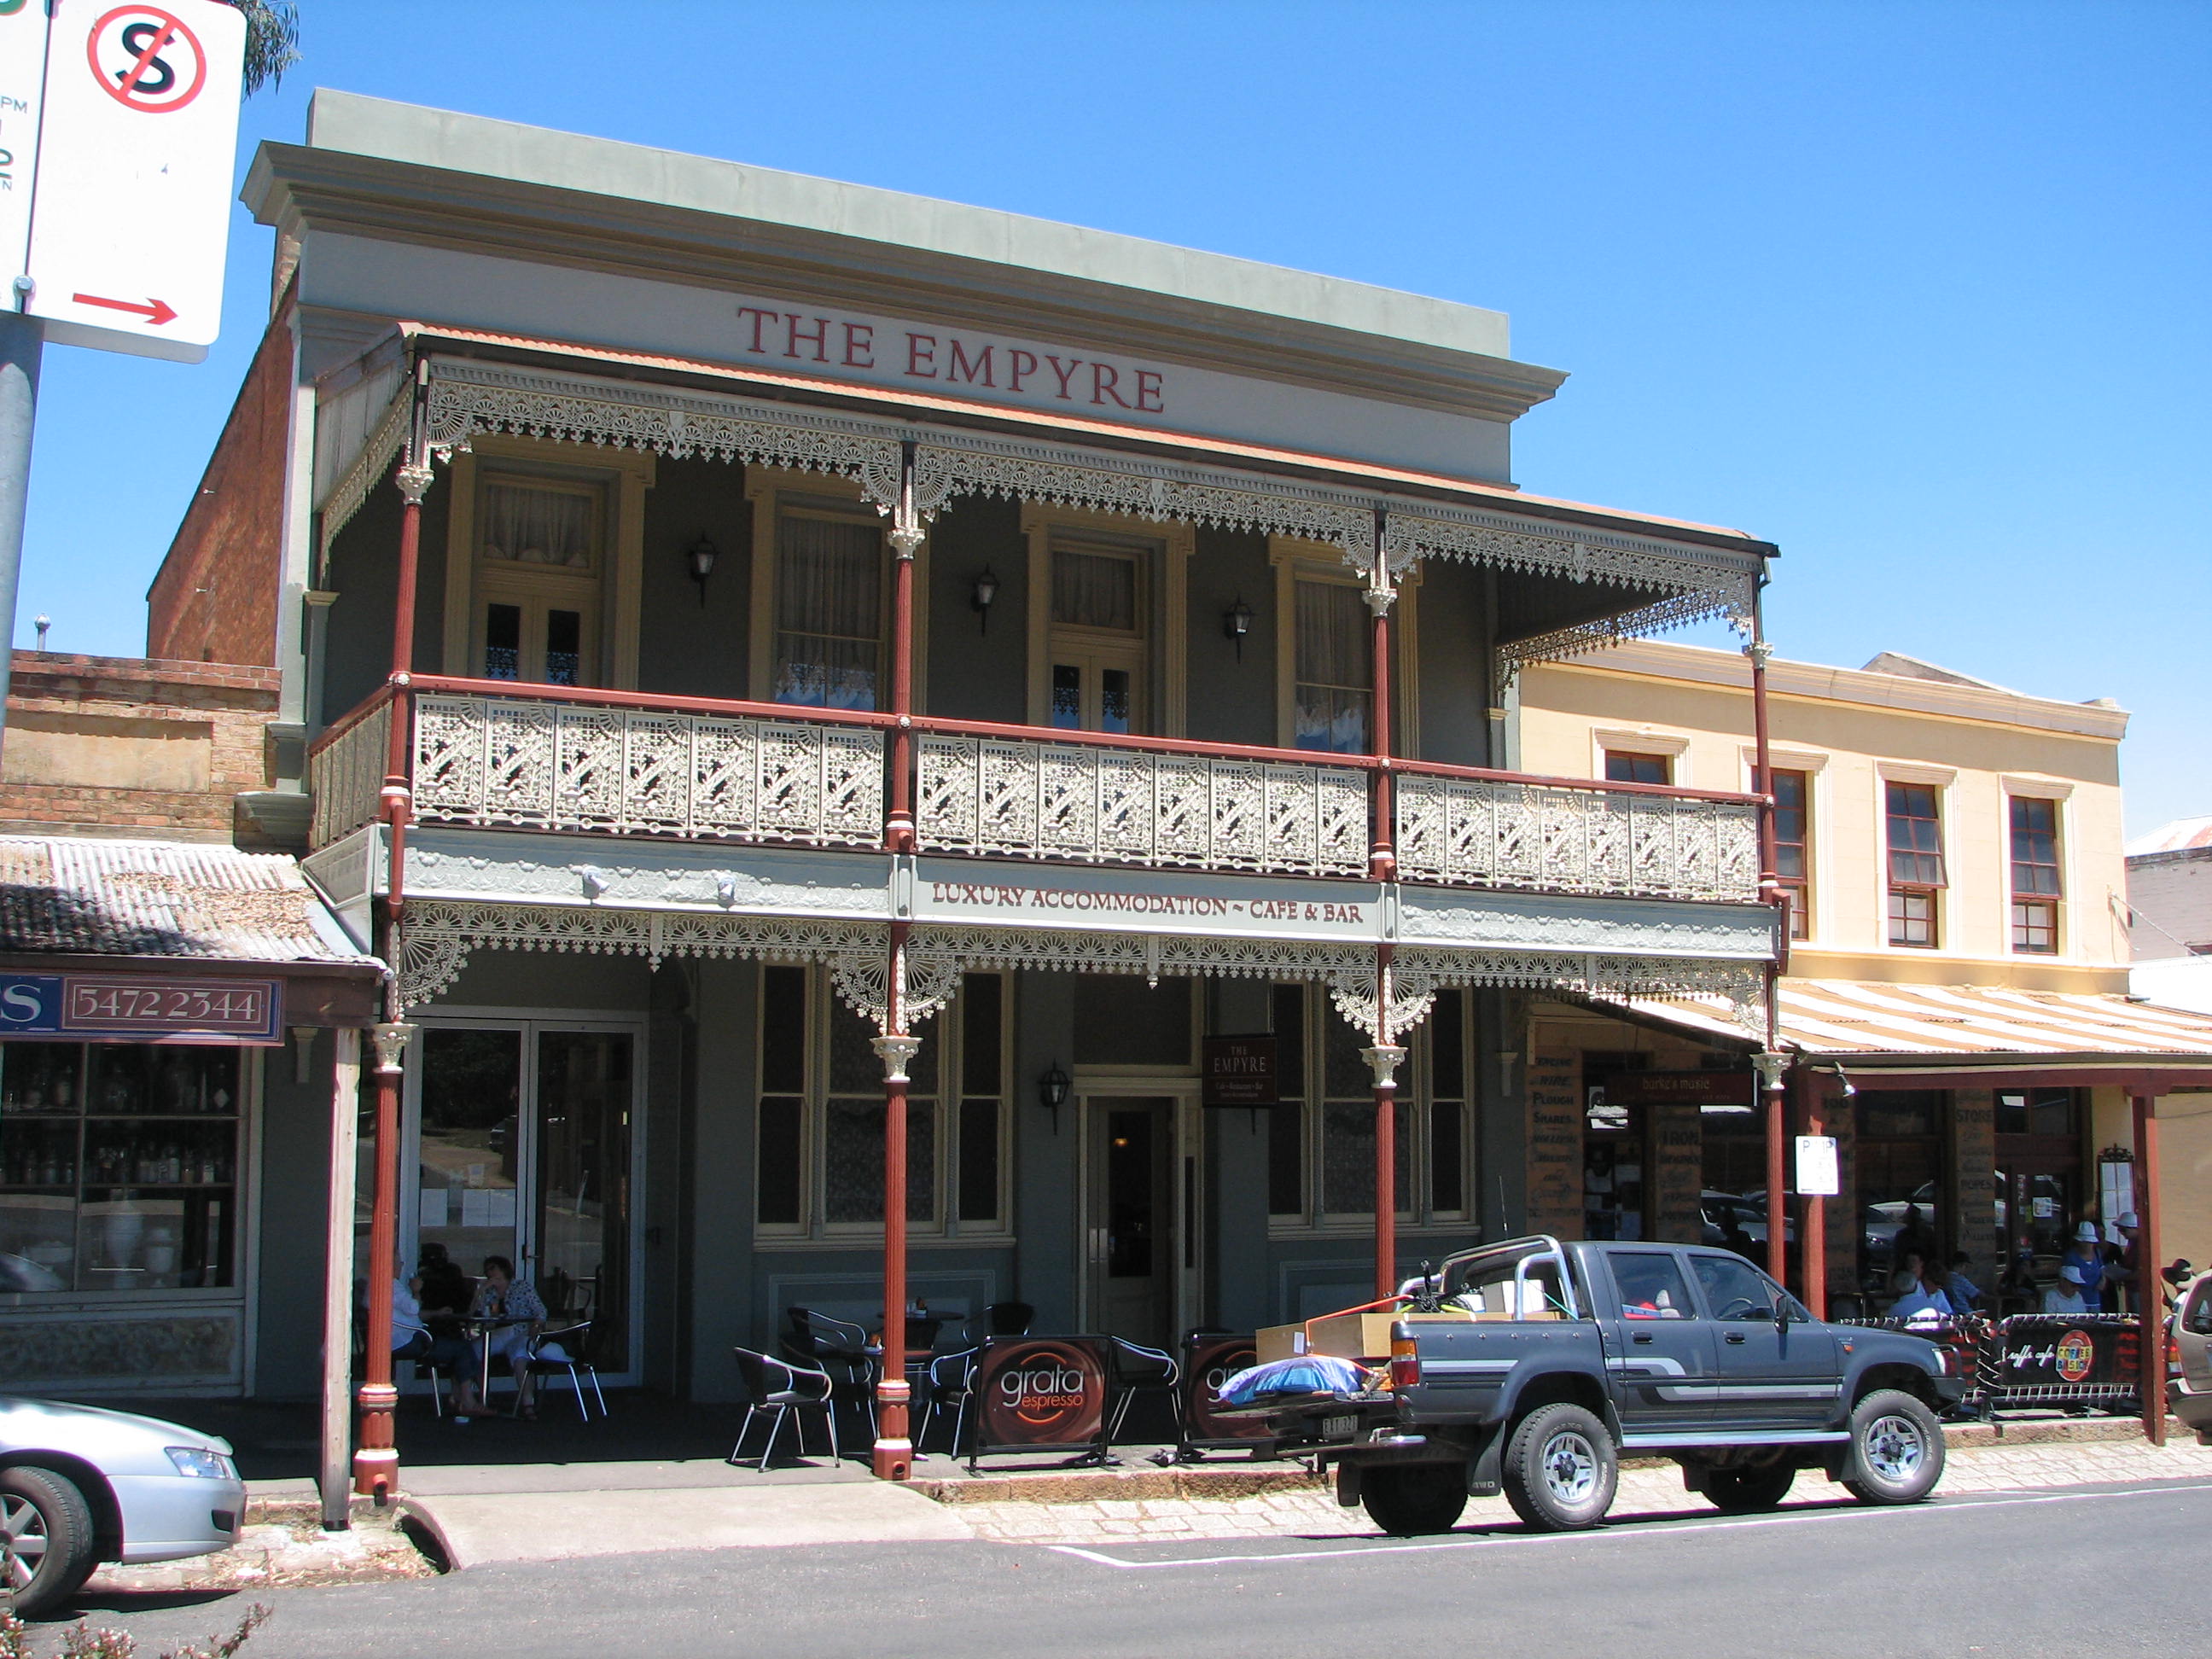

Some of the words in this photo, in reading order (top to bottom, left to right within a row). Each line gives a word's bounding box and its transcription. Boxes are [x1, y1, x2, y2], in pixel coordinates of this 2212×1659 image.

[737, 306, 875, 369] THE
[905, 333, 1165, 414] EMPYRE
[932, 882, 1027, 907] LUXURY
[1031, 888, 1229, 917] ACCOMMODATION
[1250, 899, 1298, 921] CAFE
[1324, 903, 1365, 924] BAR
[79, 988, 161, 1016] 5472
[168, 992, 256, 1020] 2344
[1214, 1057, 1267, 1073] EMPYRE
[1231, 1045, 1248, 1057] THE
[1000, 1364, 1084, 1408] grata
[1022, 1394, 1084, 1412] espresso
